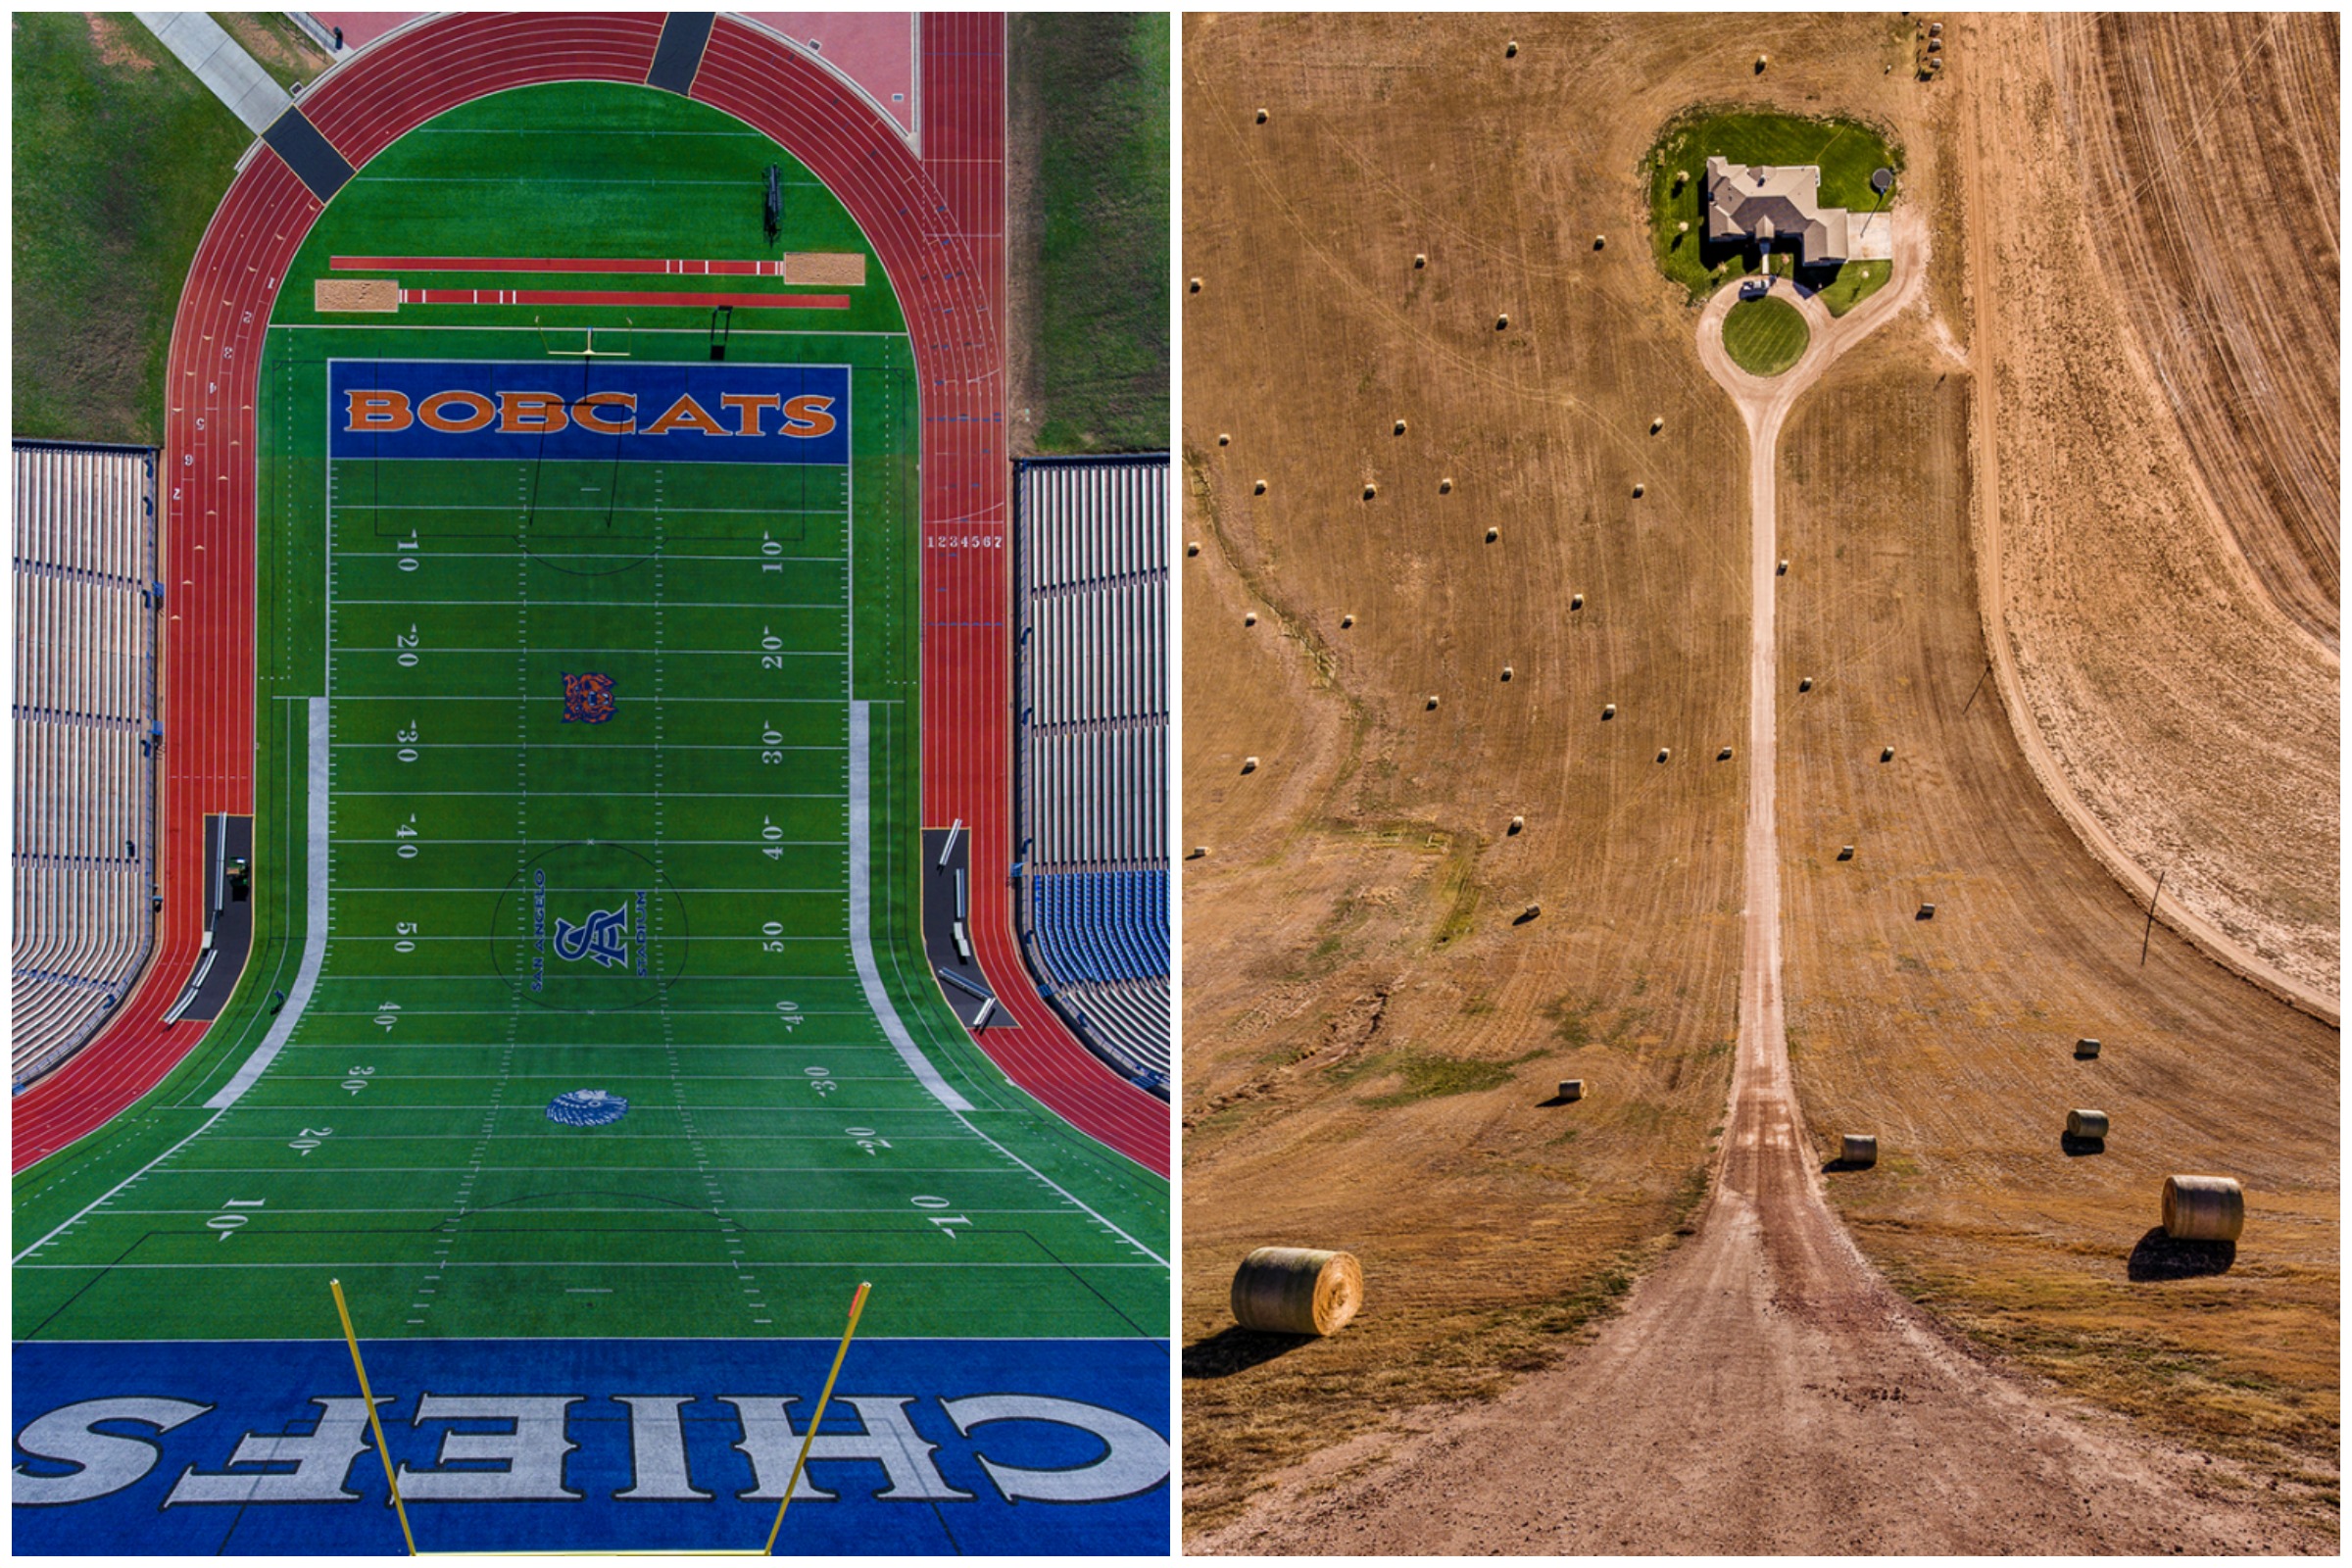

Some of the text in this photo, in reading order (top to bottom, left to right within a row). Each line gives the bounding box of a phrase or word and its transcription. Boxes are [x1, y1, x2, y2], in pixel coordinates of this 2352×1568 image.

[344, 390, 837, 438] BOBCATS
[397, 540, 419, 572] 10
[761, 541, 783, 573] 10
[397, 634, 419, 667] 20
[761, 636, 783, 669] 20
[397, 729, 418, 762] 30
[761, 730, 783, 764] 30
[396, 824, 418, 858] 40
[761, 825, 783, 860] 40
[394, 921, 418, 953] 50
[531, 868, 546, 993] SAN ANGELO
[635, 890, 647, 978] STADIUM
[761, 921, 784, 953] 50
[373, 1001, 402, 1025] 40
[776, 1001, 805, 1025] 40
[341, 1065, 375, 1090] 30
[804, 1066, 837, 1092] 30
[288, 1127, 334, 1150] 20
[845, 1127, 893, 1150] 20
[206, 1198, 267, 1229] 10
[910, 1196, 973, 1226] 10
[12, 1394, 1170, 1508] CHIEFS
